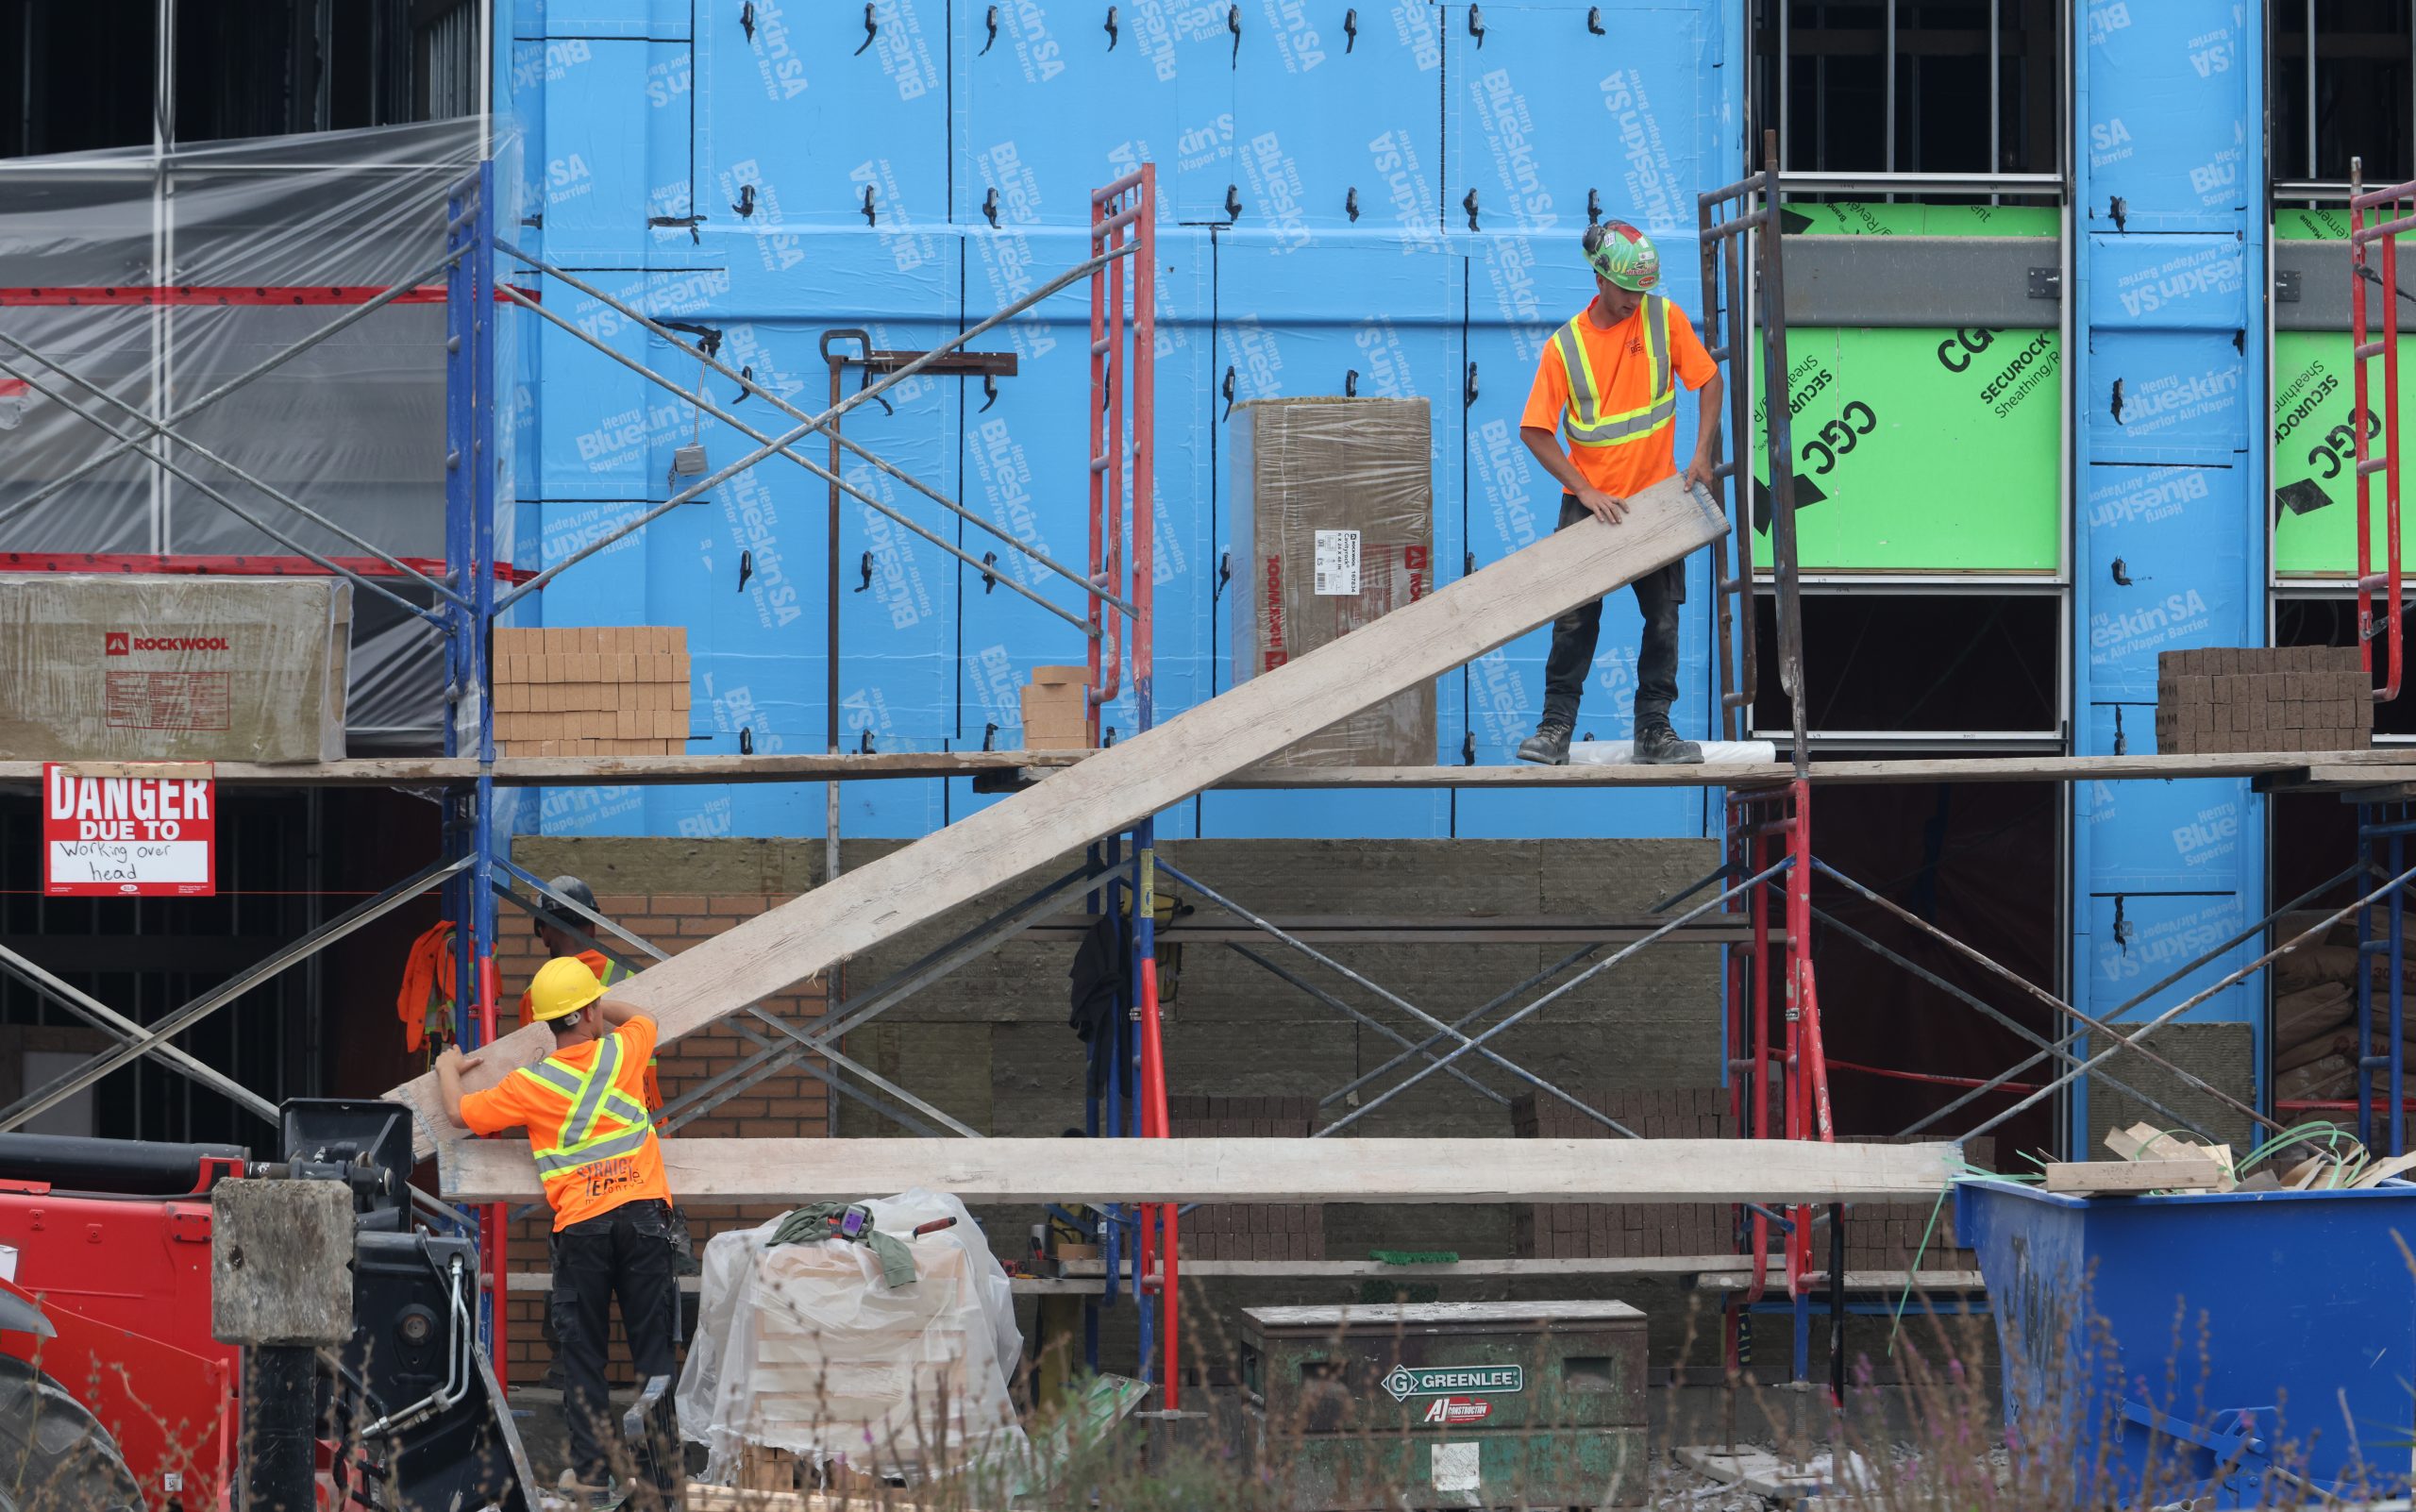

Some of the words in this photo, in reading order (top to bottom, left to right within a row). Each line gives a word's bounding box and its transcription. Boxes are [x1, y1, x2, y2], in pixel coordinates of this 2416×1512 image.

[1131, 17, 1151, 57] Henry
[1390, 7, 1413, 46] Henry
[2187, 28, 2228, 50] Barrier
[875, 36, 896, 76] Henry
[914, 37, 940, 90] Superior
[1015, 41, 1037, 85] Barrier
[1032, 42, 1066, 83] SA
[1275, 31, 1298, 76] Barrier
[1293, 31, 1327, 73] SA
[2189, 45, 2230, 79] SA
[758, 59, 780, 102] Barrier
[776, 58, 809, 100] SA
[1598, 69, 1633, 114] SA
[1628, 68, 1651, 111] Barrier
[1481, 67, 1542, 194] Blueskin
[1513, 93, 1535, 134] Henry
[2090, 117, 2132, 151] SA
[1368, 130, 1402, 173] SA
[1398, 128, 1420, 172] Barrier
[1468, 80, 1494, 132] Superior
[1487, 135, 1515, 192] Air/Vapor
[1643, 113, 1671, 170] Air/Vapor
[548, 153, 591, 188] SA
[1238, 143, 1263, 195] Superior
[1283, 157, 1305, 198] Henry
[1610, 109, 1676, 234] Blueskin
[2091, 146, 2134, 168] Barrier
[549, 181, 593, 206] Barrier
[879, 159, 899, 201] Barrier
[1020, 166, 1043, 207] Henry
[1623, 171, 1646, 210] Henry
[1664, 172, 1689, 224] Superior
[763, 185, 784, 226] Henry
[2118, 269, 2159, 288] Barrier
[2161, 247, 2217, 274] Air/Vapor
[2120, 283, 2161, 318] SA
[1261, 330, 1284, 372] Henry
[1980, 332, 2053, 406] SECUROCK
[2120, 369, 2237, 425] Blueskin
[2139, 374, 2180, 396] Henry
[602, 408, 643, 430] Henry
[2125, 413, 2176, 438] Superior
[2179, 395, 2236, 421] Air/Vapor
[966, 429, 990, 485] Superior
[1468, 429, 1492, 483] Superior
[1801, 400, 1877, 475] CGC
[980, 417, 1044, 547] Blueskin
[1010, 443, 1032, 484] Henry
[1511, 445, 1533, 485] Henry
[757, 485, 779, 527] Henry
[2089, 477, 2144, 502] Air/Vapor
[2089, 472, 2209, 529] Blueskin
[2144, 501, 2183, 524] Henry
[750, 583, 774, 630] Barrier
[768, 585, 802, 629] SA
[910, 563, 933, 618] Superior
[1267, 554, 1283, 647] ROCKWOOL
[2165, 588, 2208, 623] SA
[133, 637, 229, 651] ROCKWOOL
[2110, 632, 2166, 662] Air/Vapor
[2168, 617, 2210, 640] Barrier
[1595, 647, 1628, 687] SA
[869, 686, 894, 730] Barrier
[1508, 670, 1530, 709] Henry
[51, 765, 210, 820] DANGER
[600, 796, 644, 818] Barrier
[2197, 801, 2237, 823] Henry
[59, 840, 127, 863] Working
[137, 844, 172, 858] over
[80, 821, 136, 841] DUE
[143, 821, 180, 841] TO
[89, 861, 137, 881] head
[2184, 840, 2236, 867] Superior
[2142, 913, 2199, 938] Air/Vapor
[1392, 1374, 1409, 1392] G
[1422, 1372, 1513, 1387] GREENLEE
[1423, 1398, 1451, 1423] AJ
[1447, 1404, 1488, 1416] CONSTRUCTION
